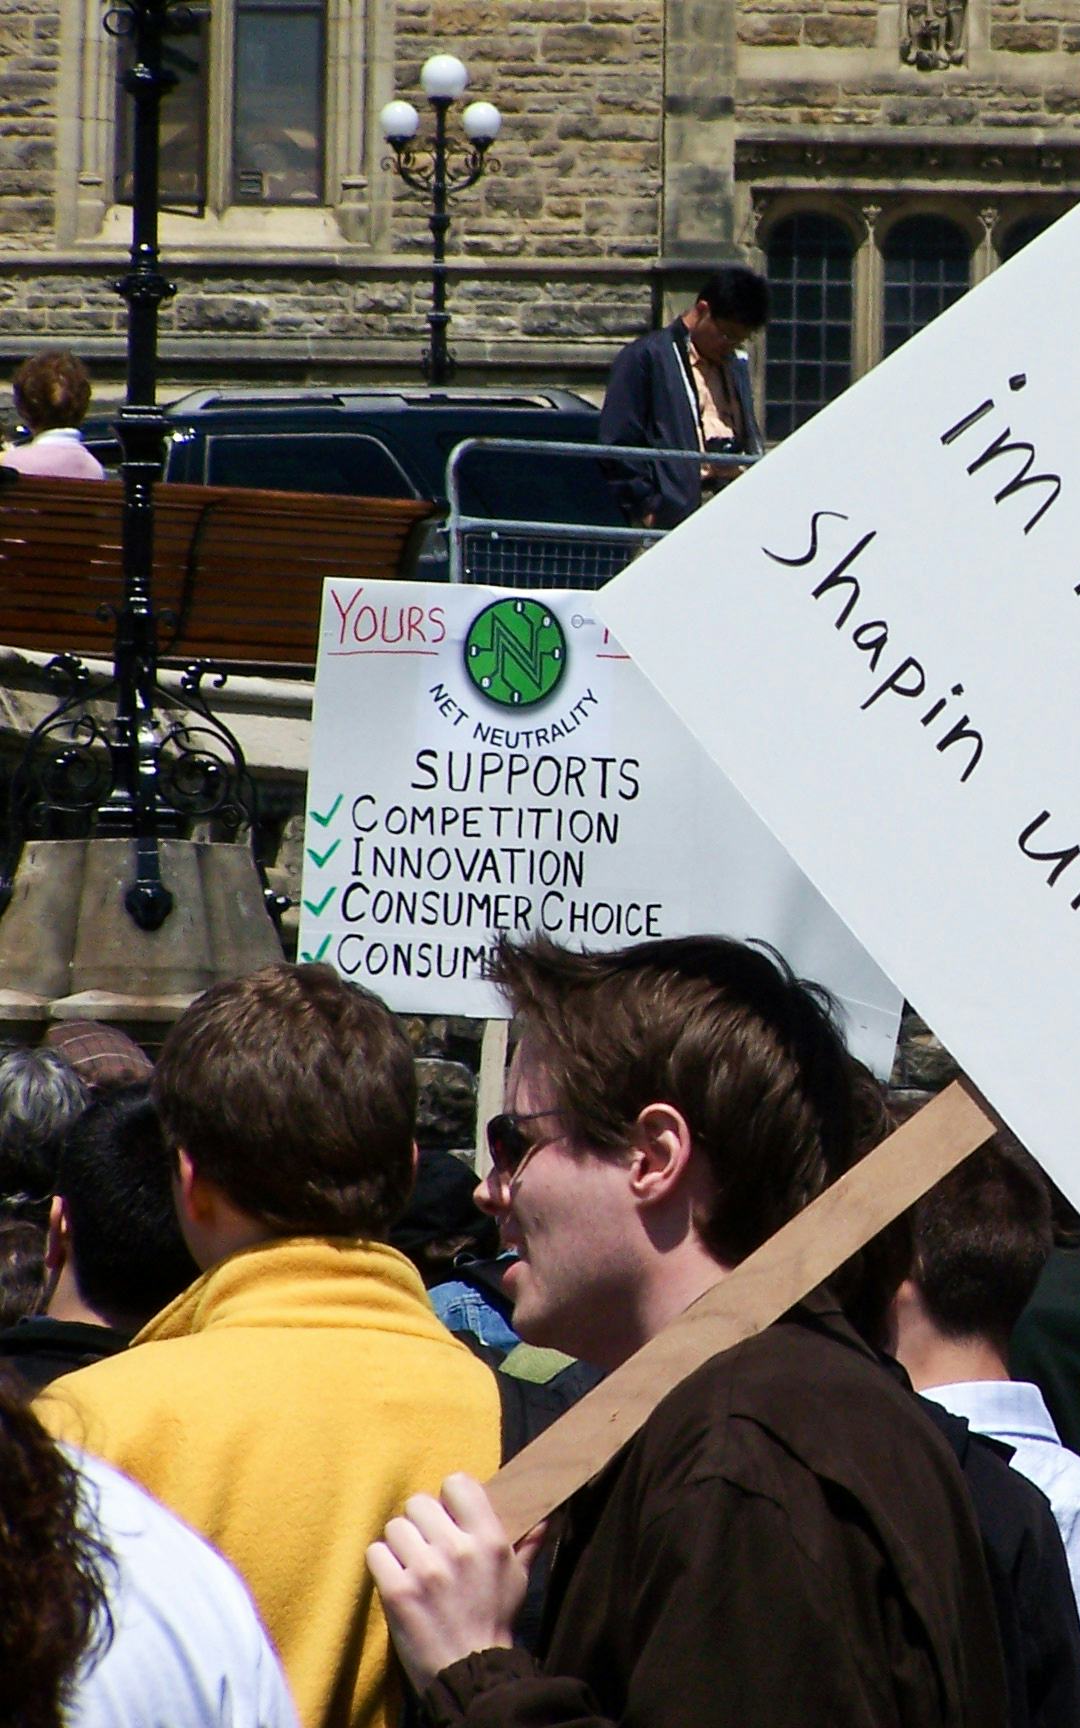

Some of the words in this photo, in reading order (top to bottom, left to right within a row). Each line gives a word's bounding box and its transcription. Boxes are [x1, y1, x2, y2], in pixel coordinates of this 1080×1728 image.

[939, 373, 1061, 535] im
[330, 587, 446, 645] YOURS
[428, 683, 469, 727] NET
[473, 689, 600, 750] NEUTRALITY
[410, 748, 641, 801] SUPPORTS
[351, 794, 620, 845] COMPETITION
[351, 837, 585, 889] INNOVATION
[340, 882, 531, 932] CONSUMER
[540, 890, 663, 937] CHOICE
